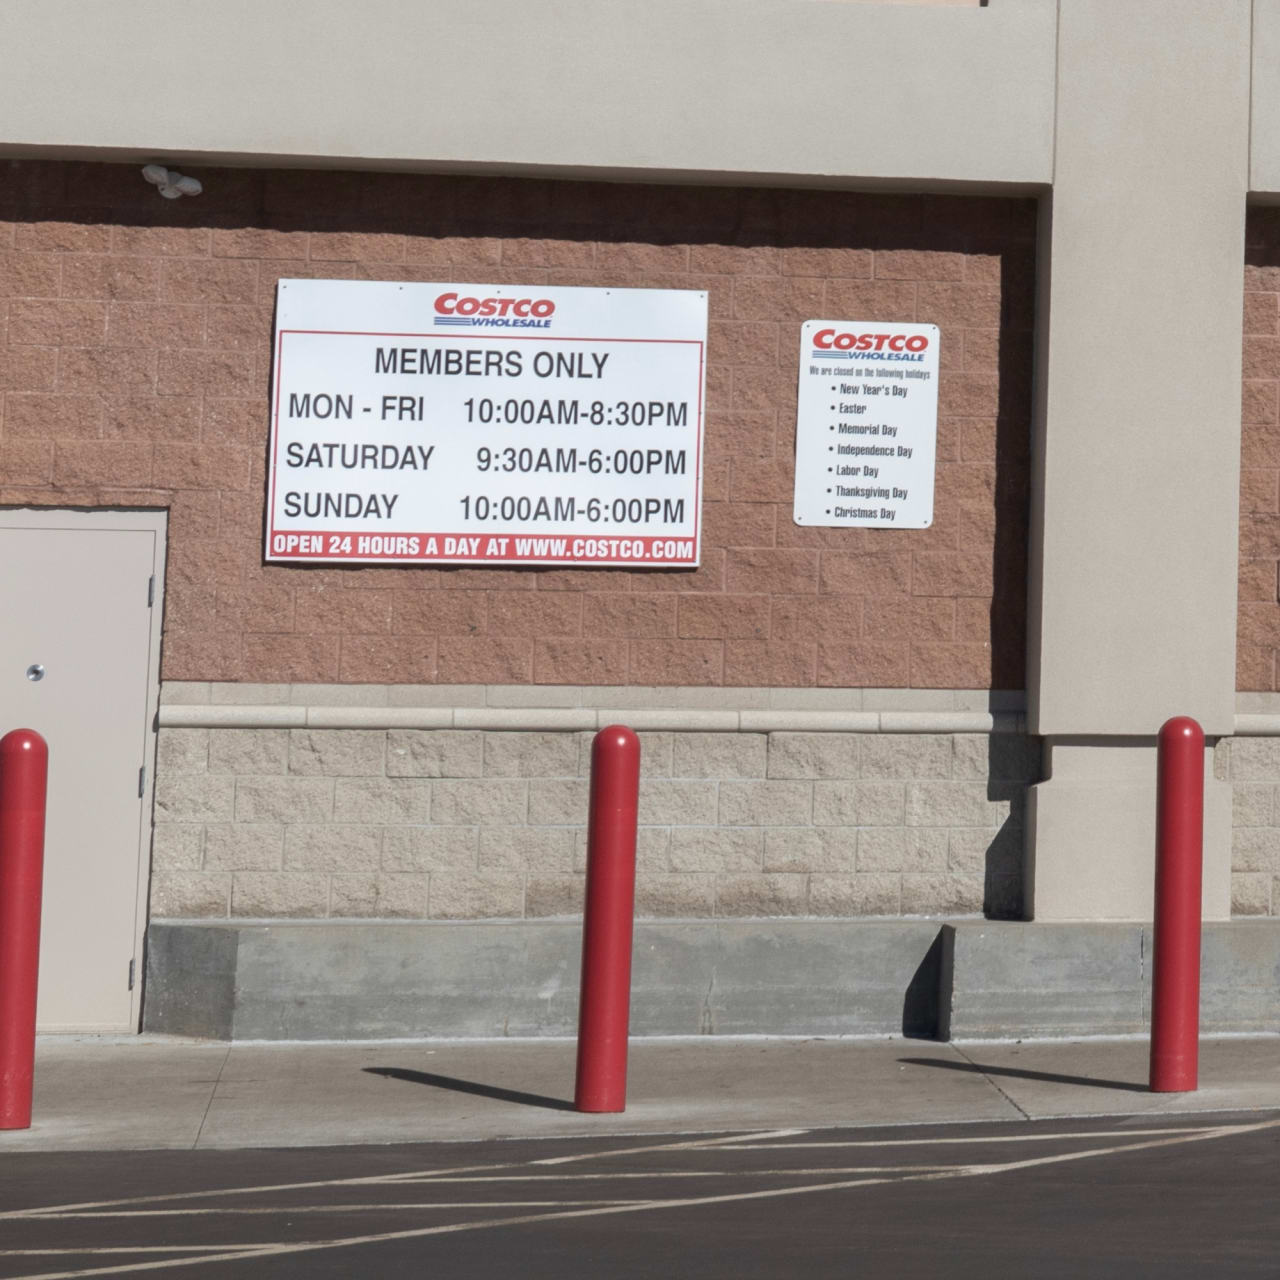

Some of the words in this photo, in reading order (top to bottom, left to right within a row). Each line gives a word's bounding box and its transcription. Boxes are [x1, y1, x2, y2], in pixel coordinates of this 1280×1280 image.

[434, 293, 555, 318] COSTCO
[471, 318, 552, 328] WHOLESALE
[812, 329, 929, 352] COSTCO
[375, 347, 523, 377] MEMBERS
[533, 351, 609, 379] ONLY
[847, 351, 925, 362] WHOLESALE
[809, 365, 819, 375] We
[821, 367, 832, 376] are
[833, 366, 854, 377] closed
[855, 369, 863, 377] on
[864, 367, 874, 377] the
[876, 368, 904, 380] following
[905, 369, 931, 381] holidays
[840, 383, 859, 395] New
[862, 384, 890, 397] Year's
[892, 385, 908, 398] Day
[289, 393, 354, 419] MON
[381, 395, 425, 421] FRI
[464, 398, 688, 426] 10:00AM-8:30PM
[839, 402, 867, 414] Easter
[838, 423, 879, 436] Memorial
[882, 424, 898, 437] Day
[286, 442, 435, 470] SATURDAY
[477, 447, 686, 475] 9:30AM-6:00PM
[837, 444, 895, 457] Independence
[897, 445, 913, 459] Day
[836, 464, 861, 476] Labor
[863, 466, 879, 479] Day
[836, 485, 890, 499] Thanksgiving
[892, 487, 908, 500] Day
[284, 491, 399, 519] SUNDAY
[460, 495, 685, 524] 10:00AM-6:00PM
[834, 506, 878, 519] Christmas
[880, 508, 896, 521] Day
[273, 534, 323, 553] OPEN
[328, 535, 352, 554] 24
[358, 536, 420, 555] HOURS
[425, 537, 438, 555] A
[444, 537, 480, 556] DAY
[486, 538, 510, 556] AT
[515, 538, 693, 558] WWW.COSTCO.COM
